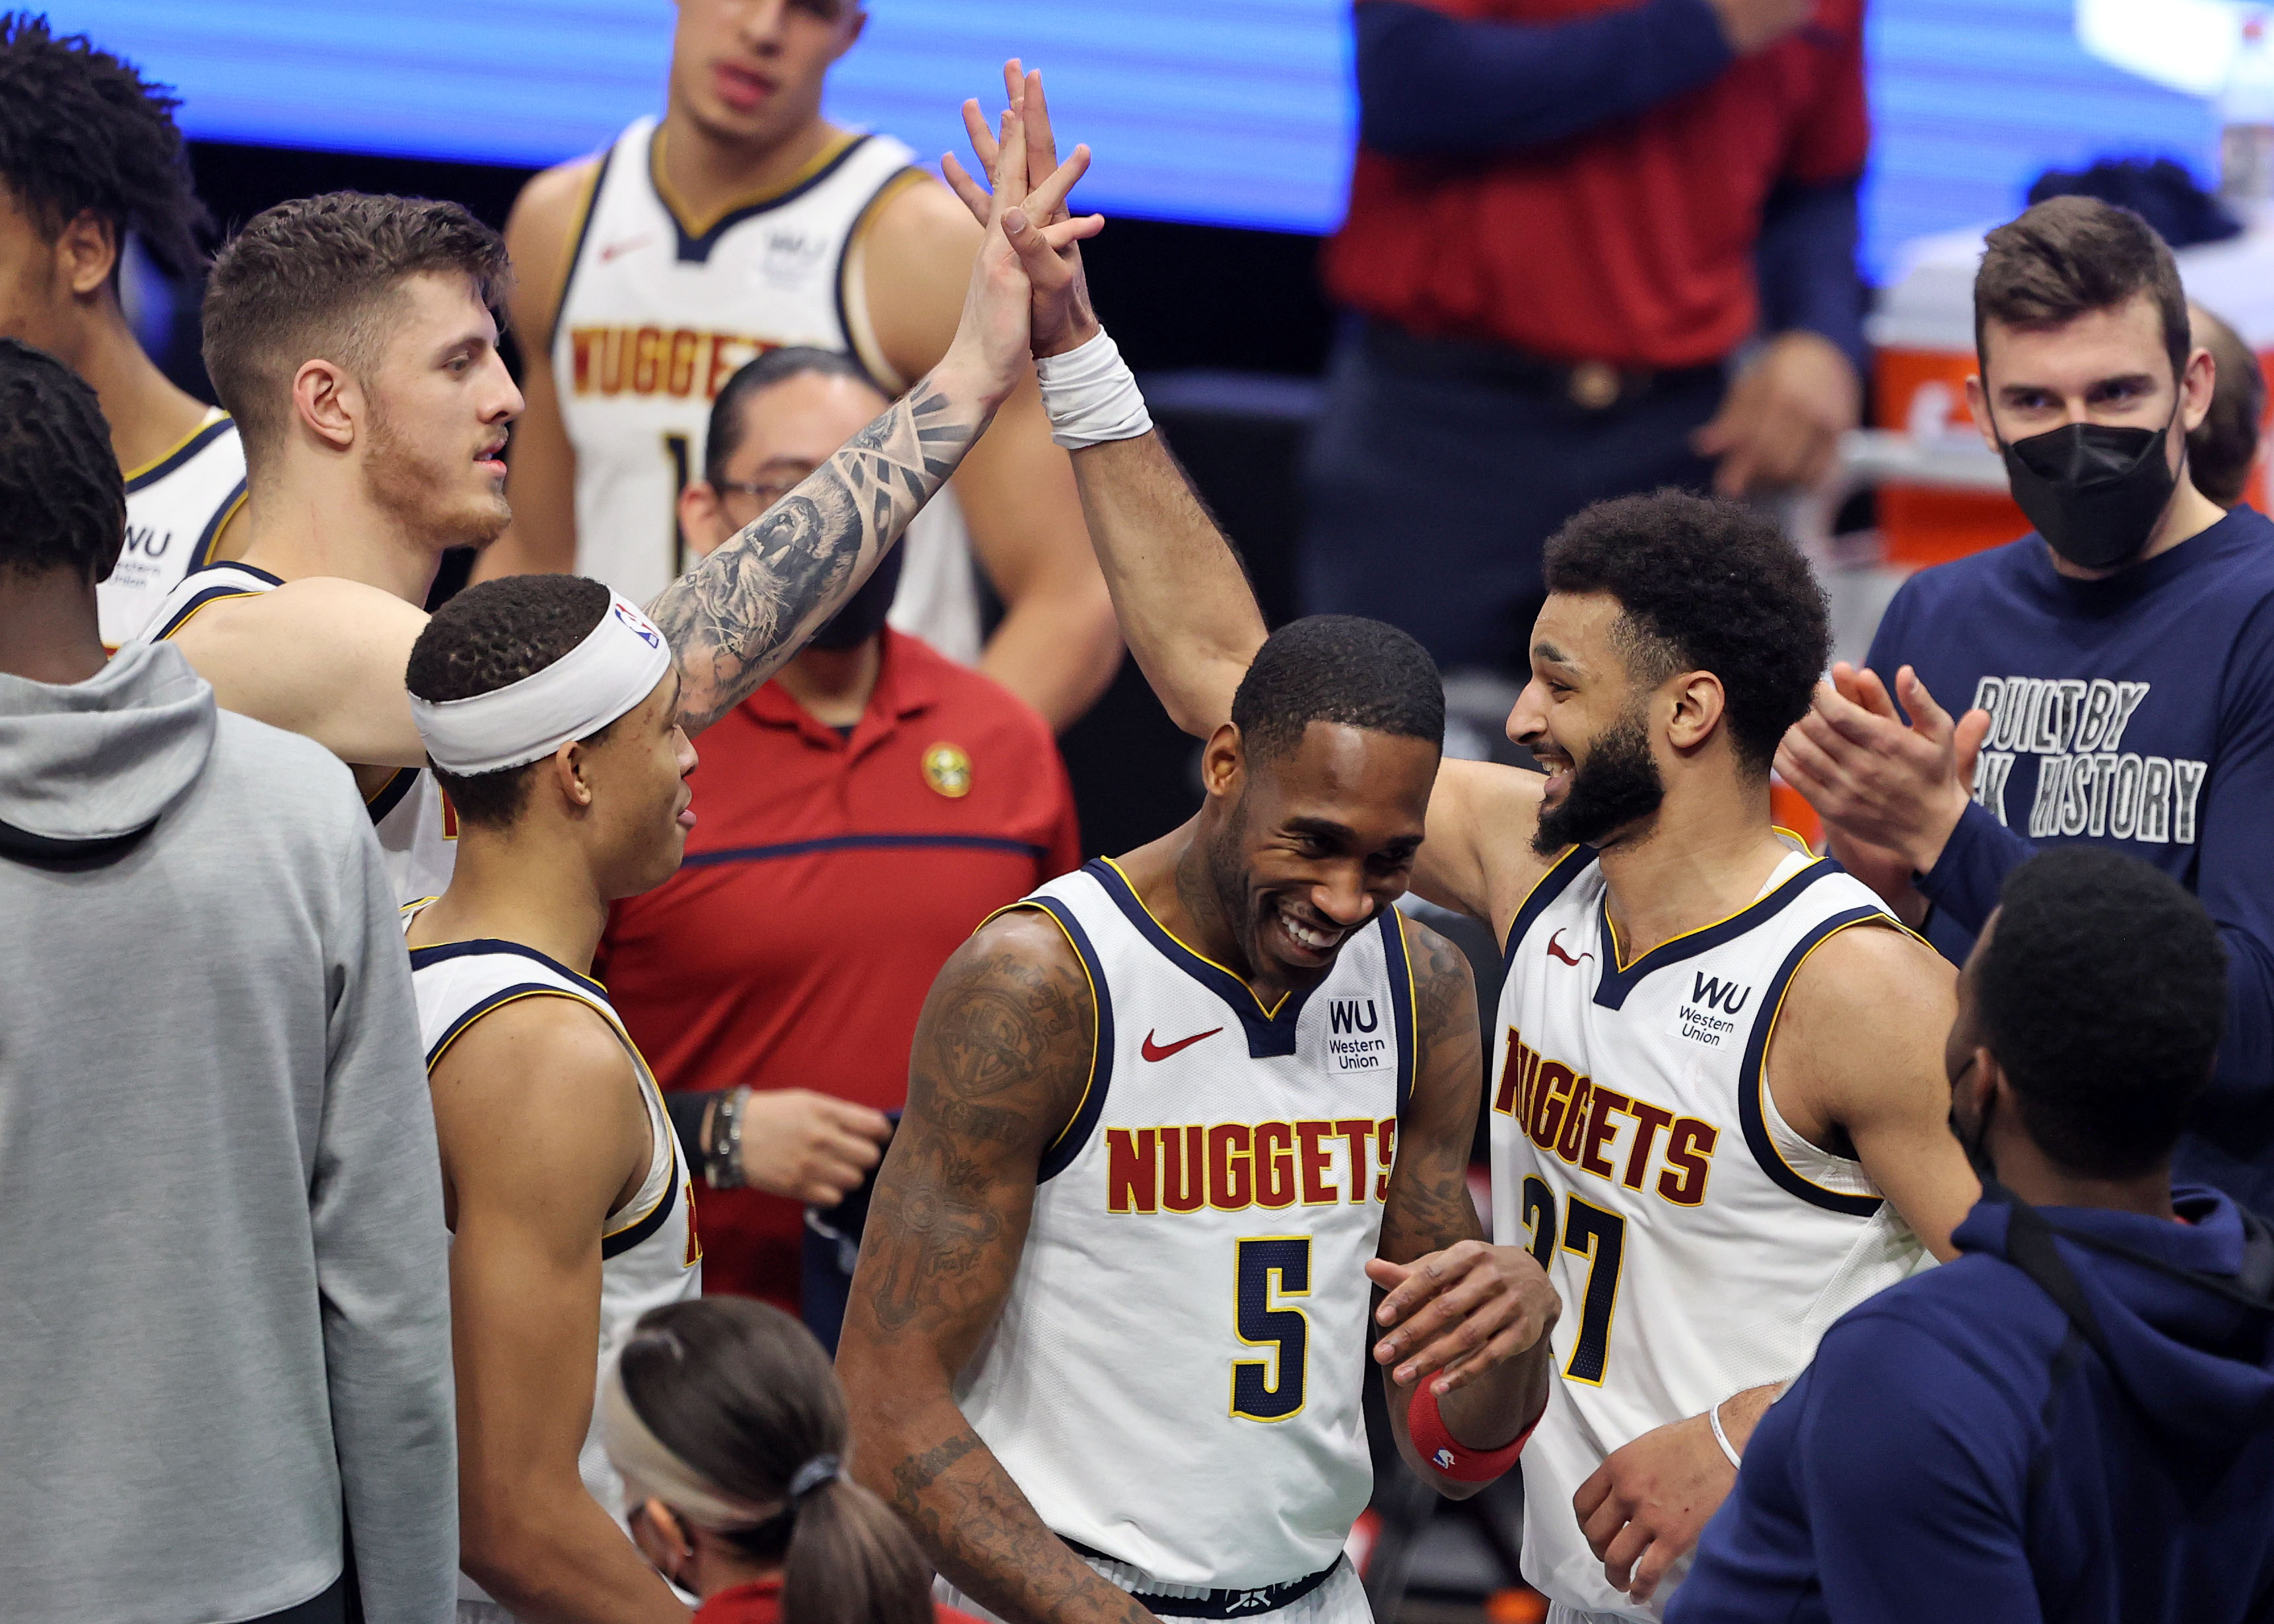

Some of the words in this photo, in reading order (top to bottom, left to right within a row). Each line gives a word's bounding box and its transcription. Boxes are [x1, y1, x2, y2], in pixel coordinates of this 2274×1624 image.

[1972, 675, 2087, 755] BUILT
[2074, 679, 2150, 753] BY
[1692, 970, 1752, 1015] WU
[1330, 999, 1378, 1034] WU
[1679, 1005, 1734, 1033] Western
[1329, 1039, 1385, 1054] Western
[1682, 1023, 1720, 1046] Union
[1338, 1054, 1379, 1069] Union
[1493, 1025, 1721, 1207] NUGGETS
[1229, 1235, 1313, 1423] 5
